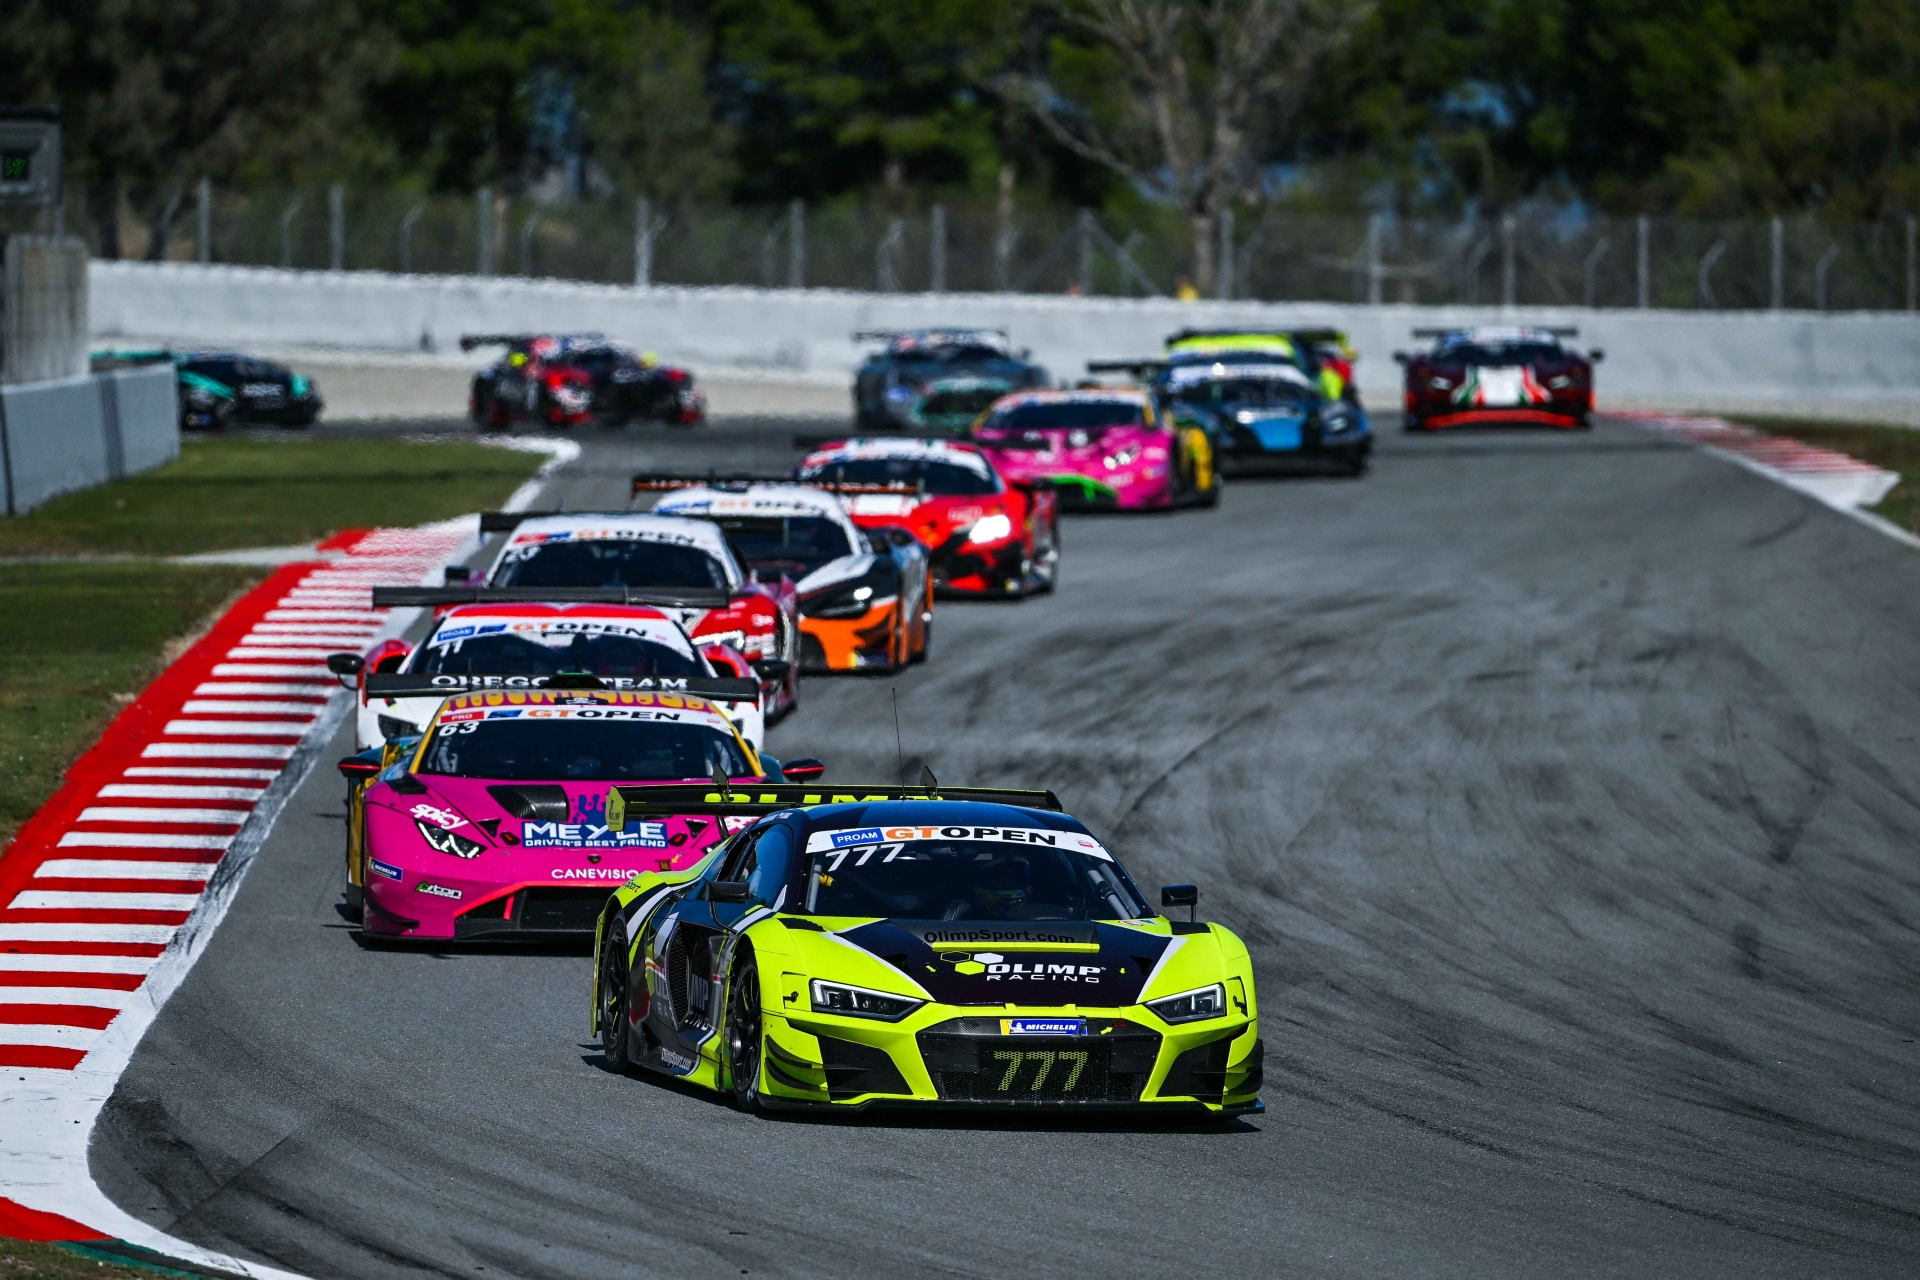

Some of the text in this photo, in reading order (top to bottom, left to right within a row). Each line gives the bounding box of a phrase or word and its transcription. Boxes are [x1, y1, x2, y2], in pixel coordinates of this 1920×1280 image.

[431, 676, 550, 689] OREGO
[528, 709, 680, 721] GTOPEN
[439, 721, 480, 736] 63
[410, 803, 469, 829] spicy
[524, 822, 665, 840] MEYLE
[836, 831, 878, 843] PROAM
[525, 839, 666, 848] DRIVER'S BEST FRIEND
[826, 842, 906, 872] 777
[551, 868, 639, 880] CANEVISIO
[924, 929, 1075, 943] OlimpSport.com
[987, 963, 1101, 976] OLIMP
[986, 974, 1100, 984] RACING
[1025, 1023, 1077, 1031] MICHELIN
[993, 1051, 1089, 1092] 777
